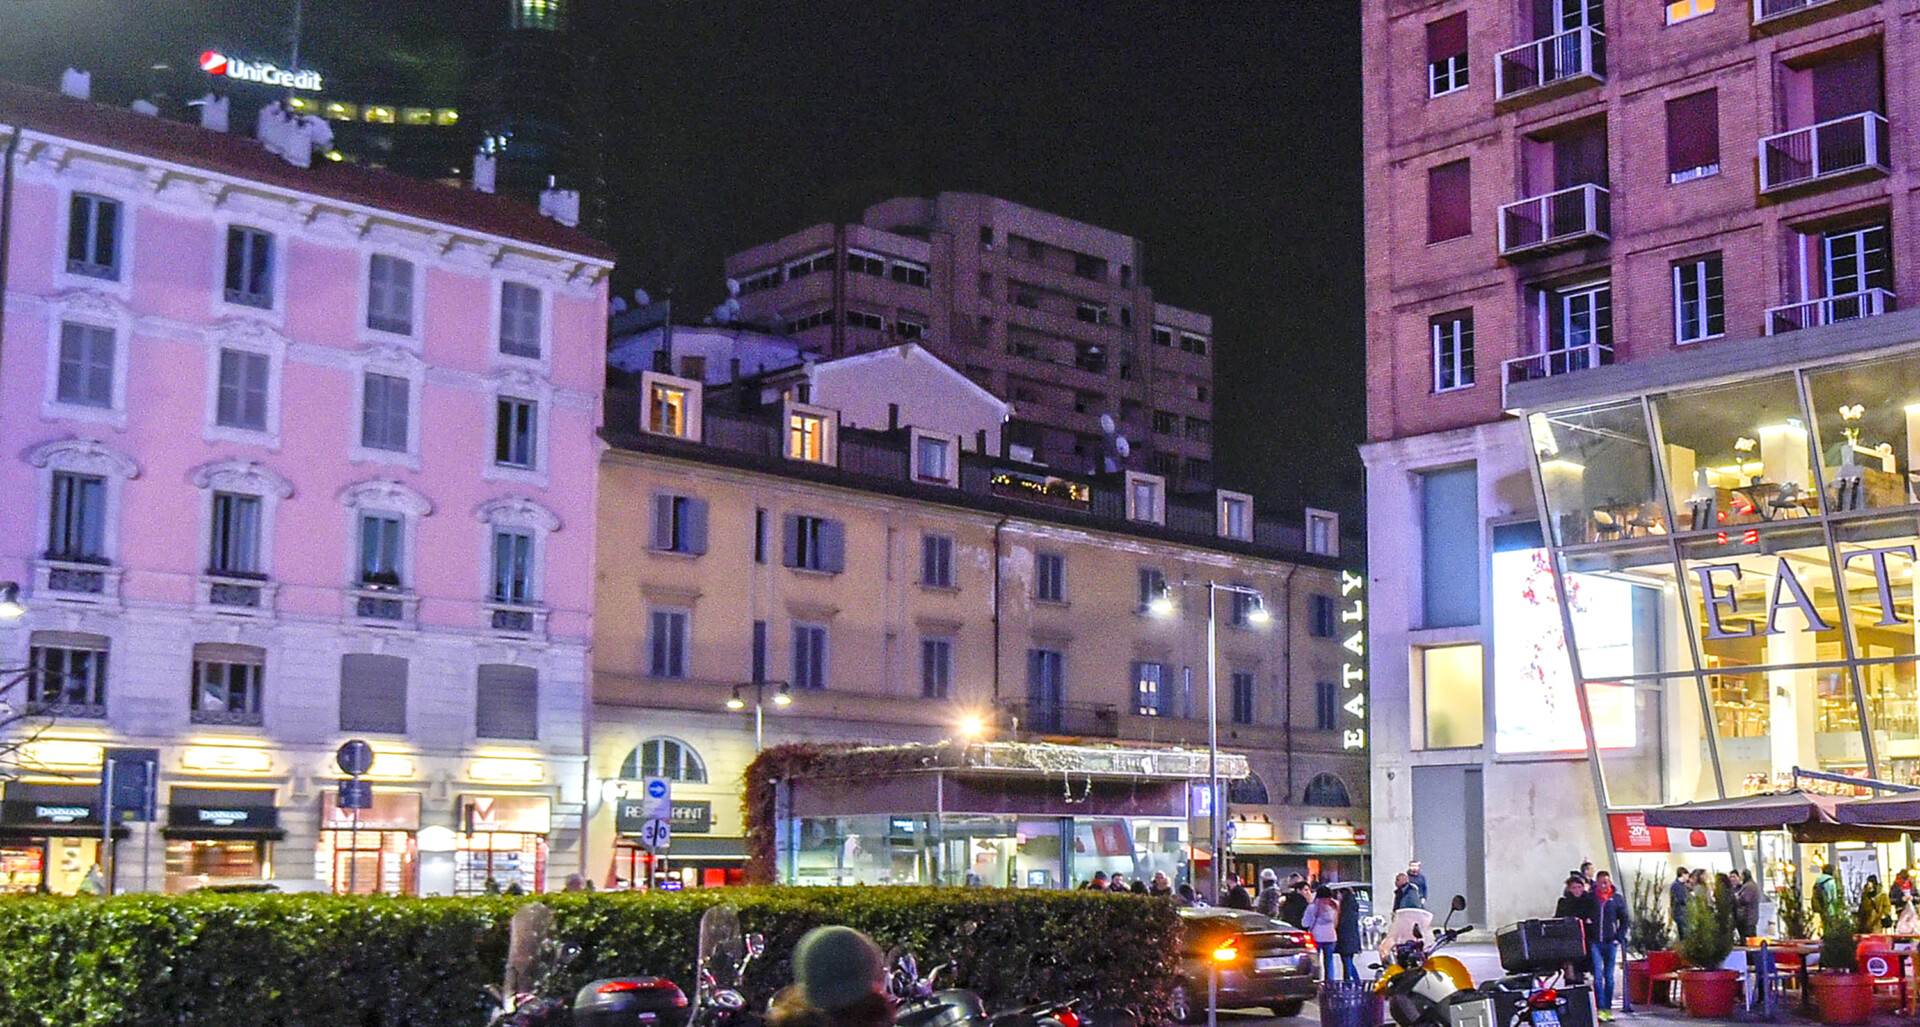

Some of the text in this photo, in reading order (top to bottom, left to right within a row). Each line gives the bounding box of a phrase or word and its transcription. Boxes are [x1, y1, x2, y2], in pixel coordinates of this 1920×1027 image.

[226, 57, 322, 91] UniCredit
[1342, 570, 1364, 749] EATALY
[624, 806, 703, 819] RERANT
[646, 826, 667, 839] 30
